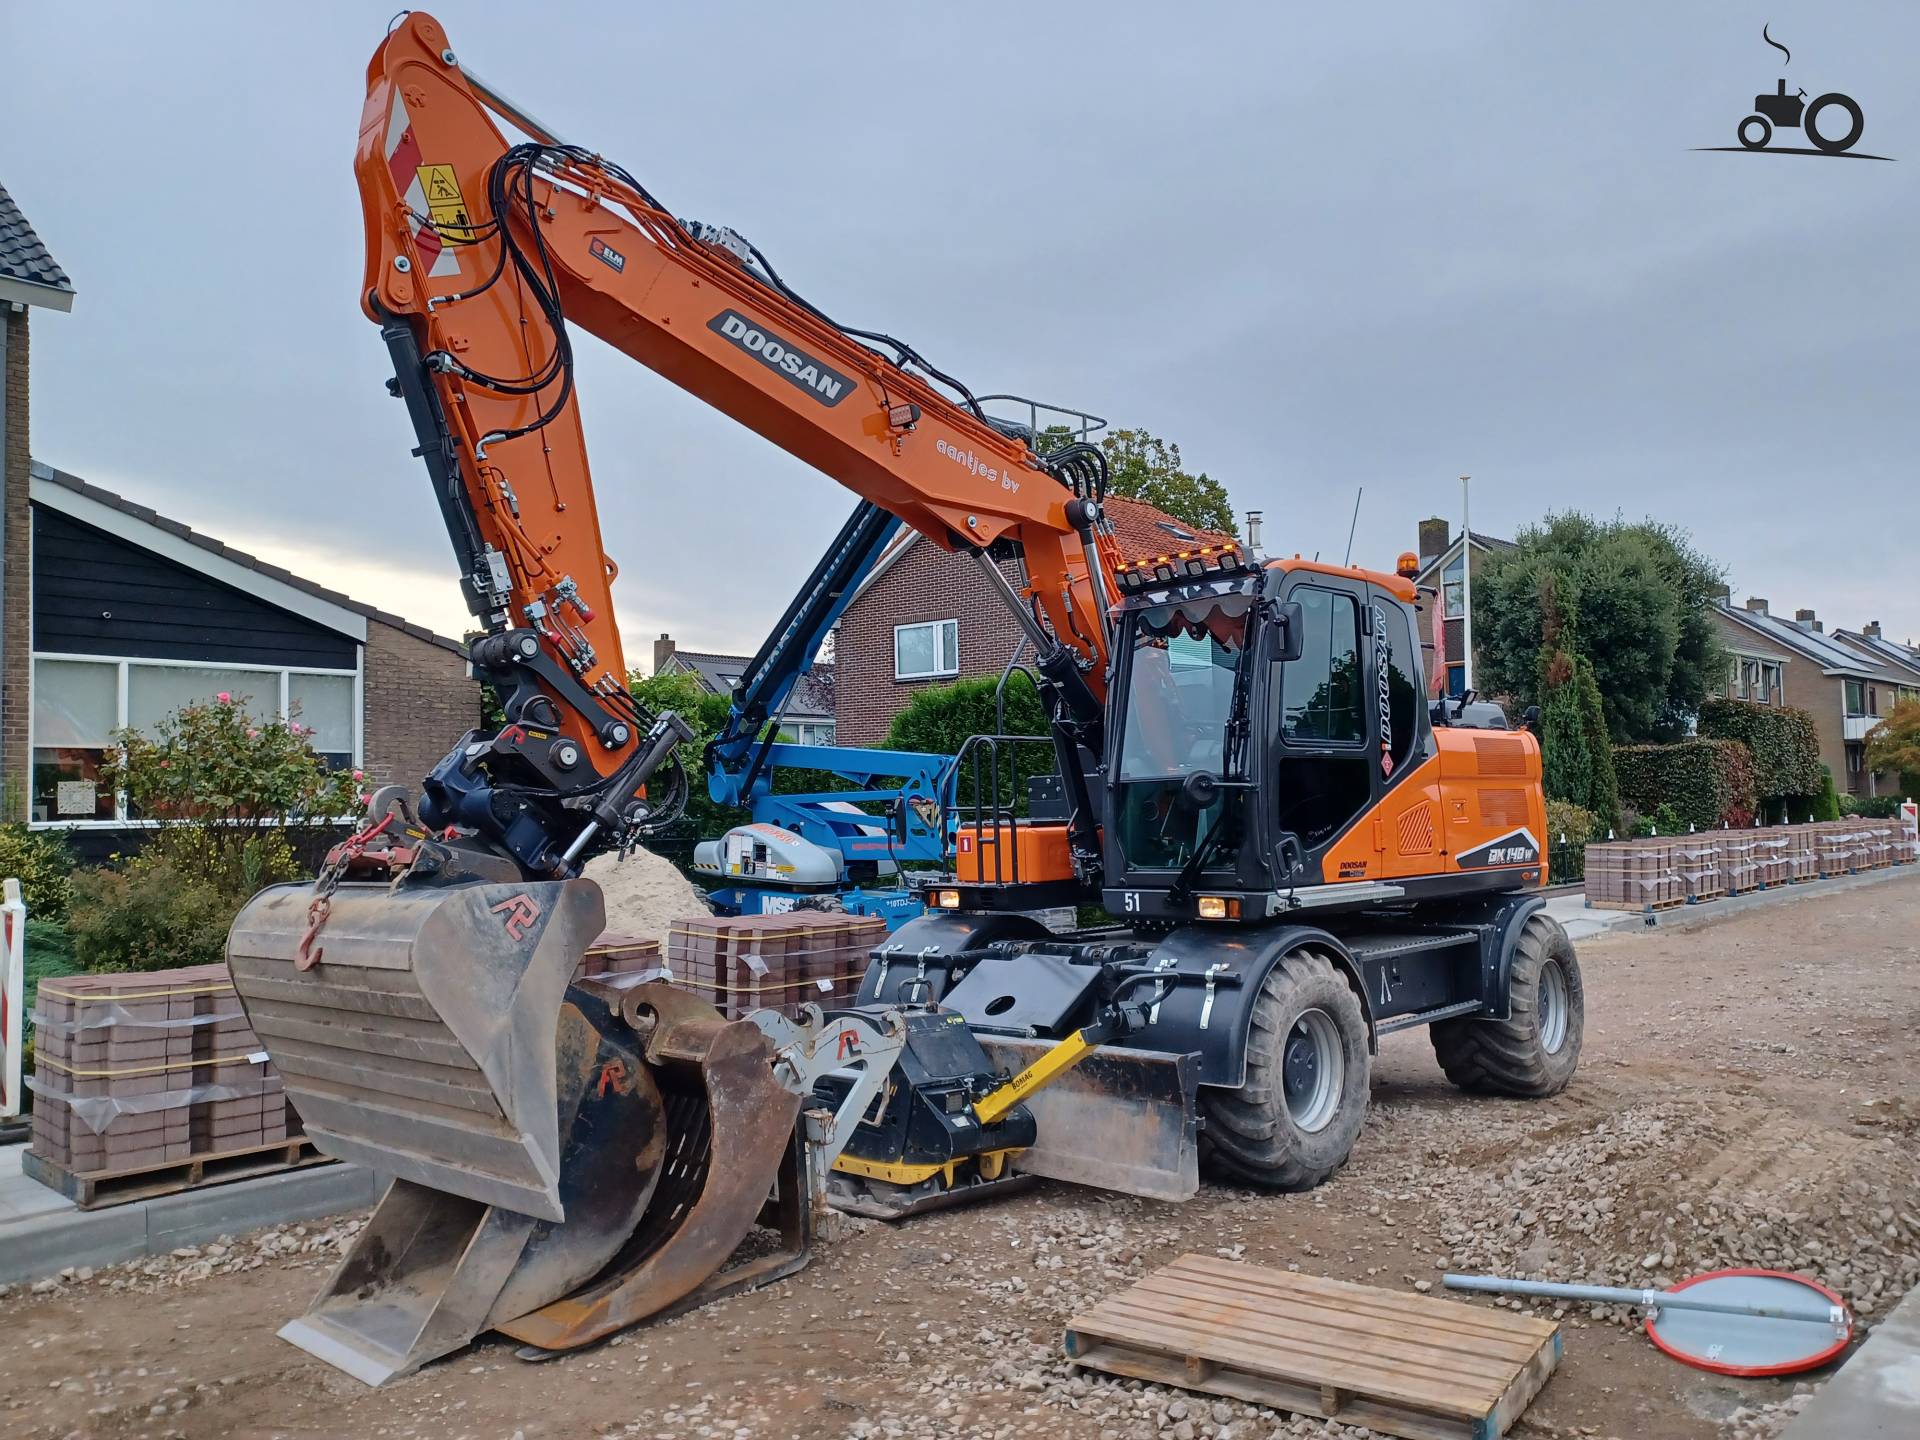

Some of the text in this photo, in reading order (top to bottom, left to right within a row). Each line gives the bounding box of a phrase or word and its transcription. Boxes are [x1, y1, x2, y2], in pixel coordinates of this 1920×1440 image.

[720, 315, 842, 400] DOOSAN
[936, 439, 1020, 494] aantjes bv
[1374, 605, 1393, 745] DOOSAN
[1124, 892, 1140, 912] 51
[1011, 1070, 1033, 1090] BOMAG
